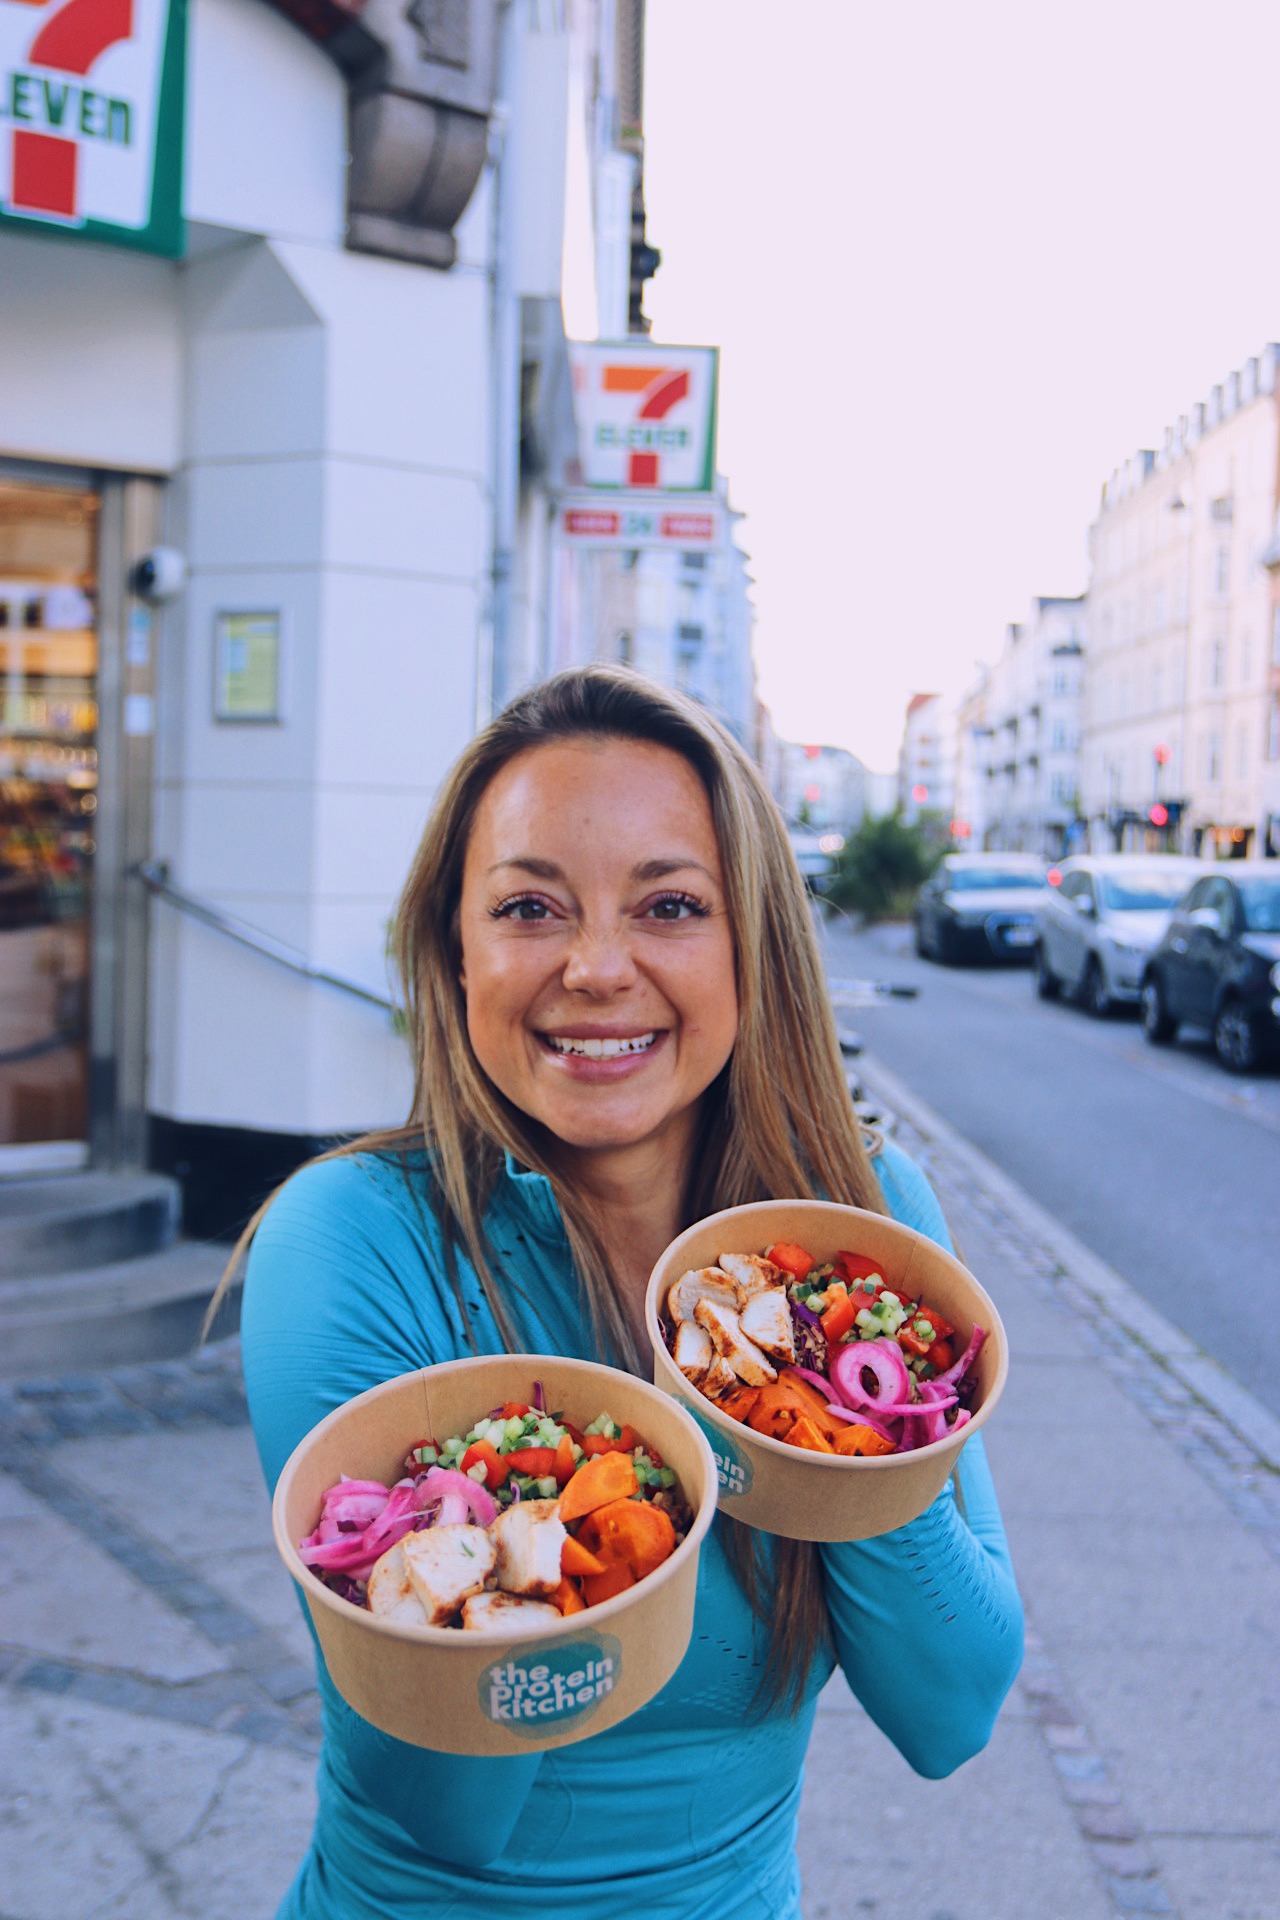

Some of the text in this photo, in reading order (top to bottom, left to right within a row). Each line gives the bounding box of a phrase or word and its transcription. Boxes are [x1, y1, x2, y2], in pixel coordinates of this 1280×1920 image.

[0, 72, 131, 147] EVEn
[604, 367, 690, 486] 7
[490, 1663, 549, 1686] the
[490, 1657, 613, 1701] protein
[490, 1676, 613, 1719] kitchen
